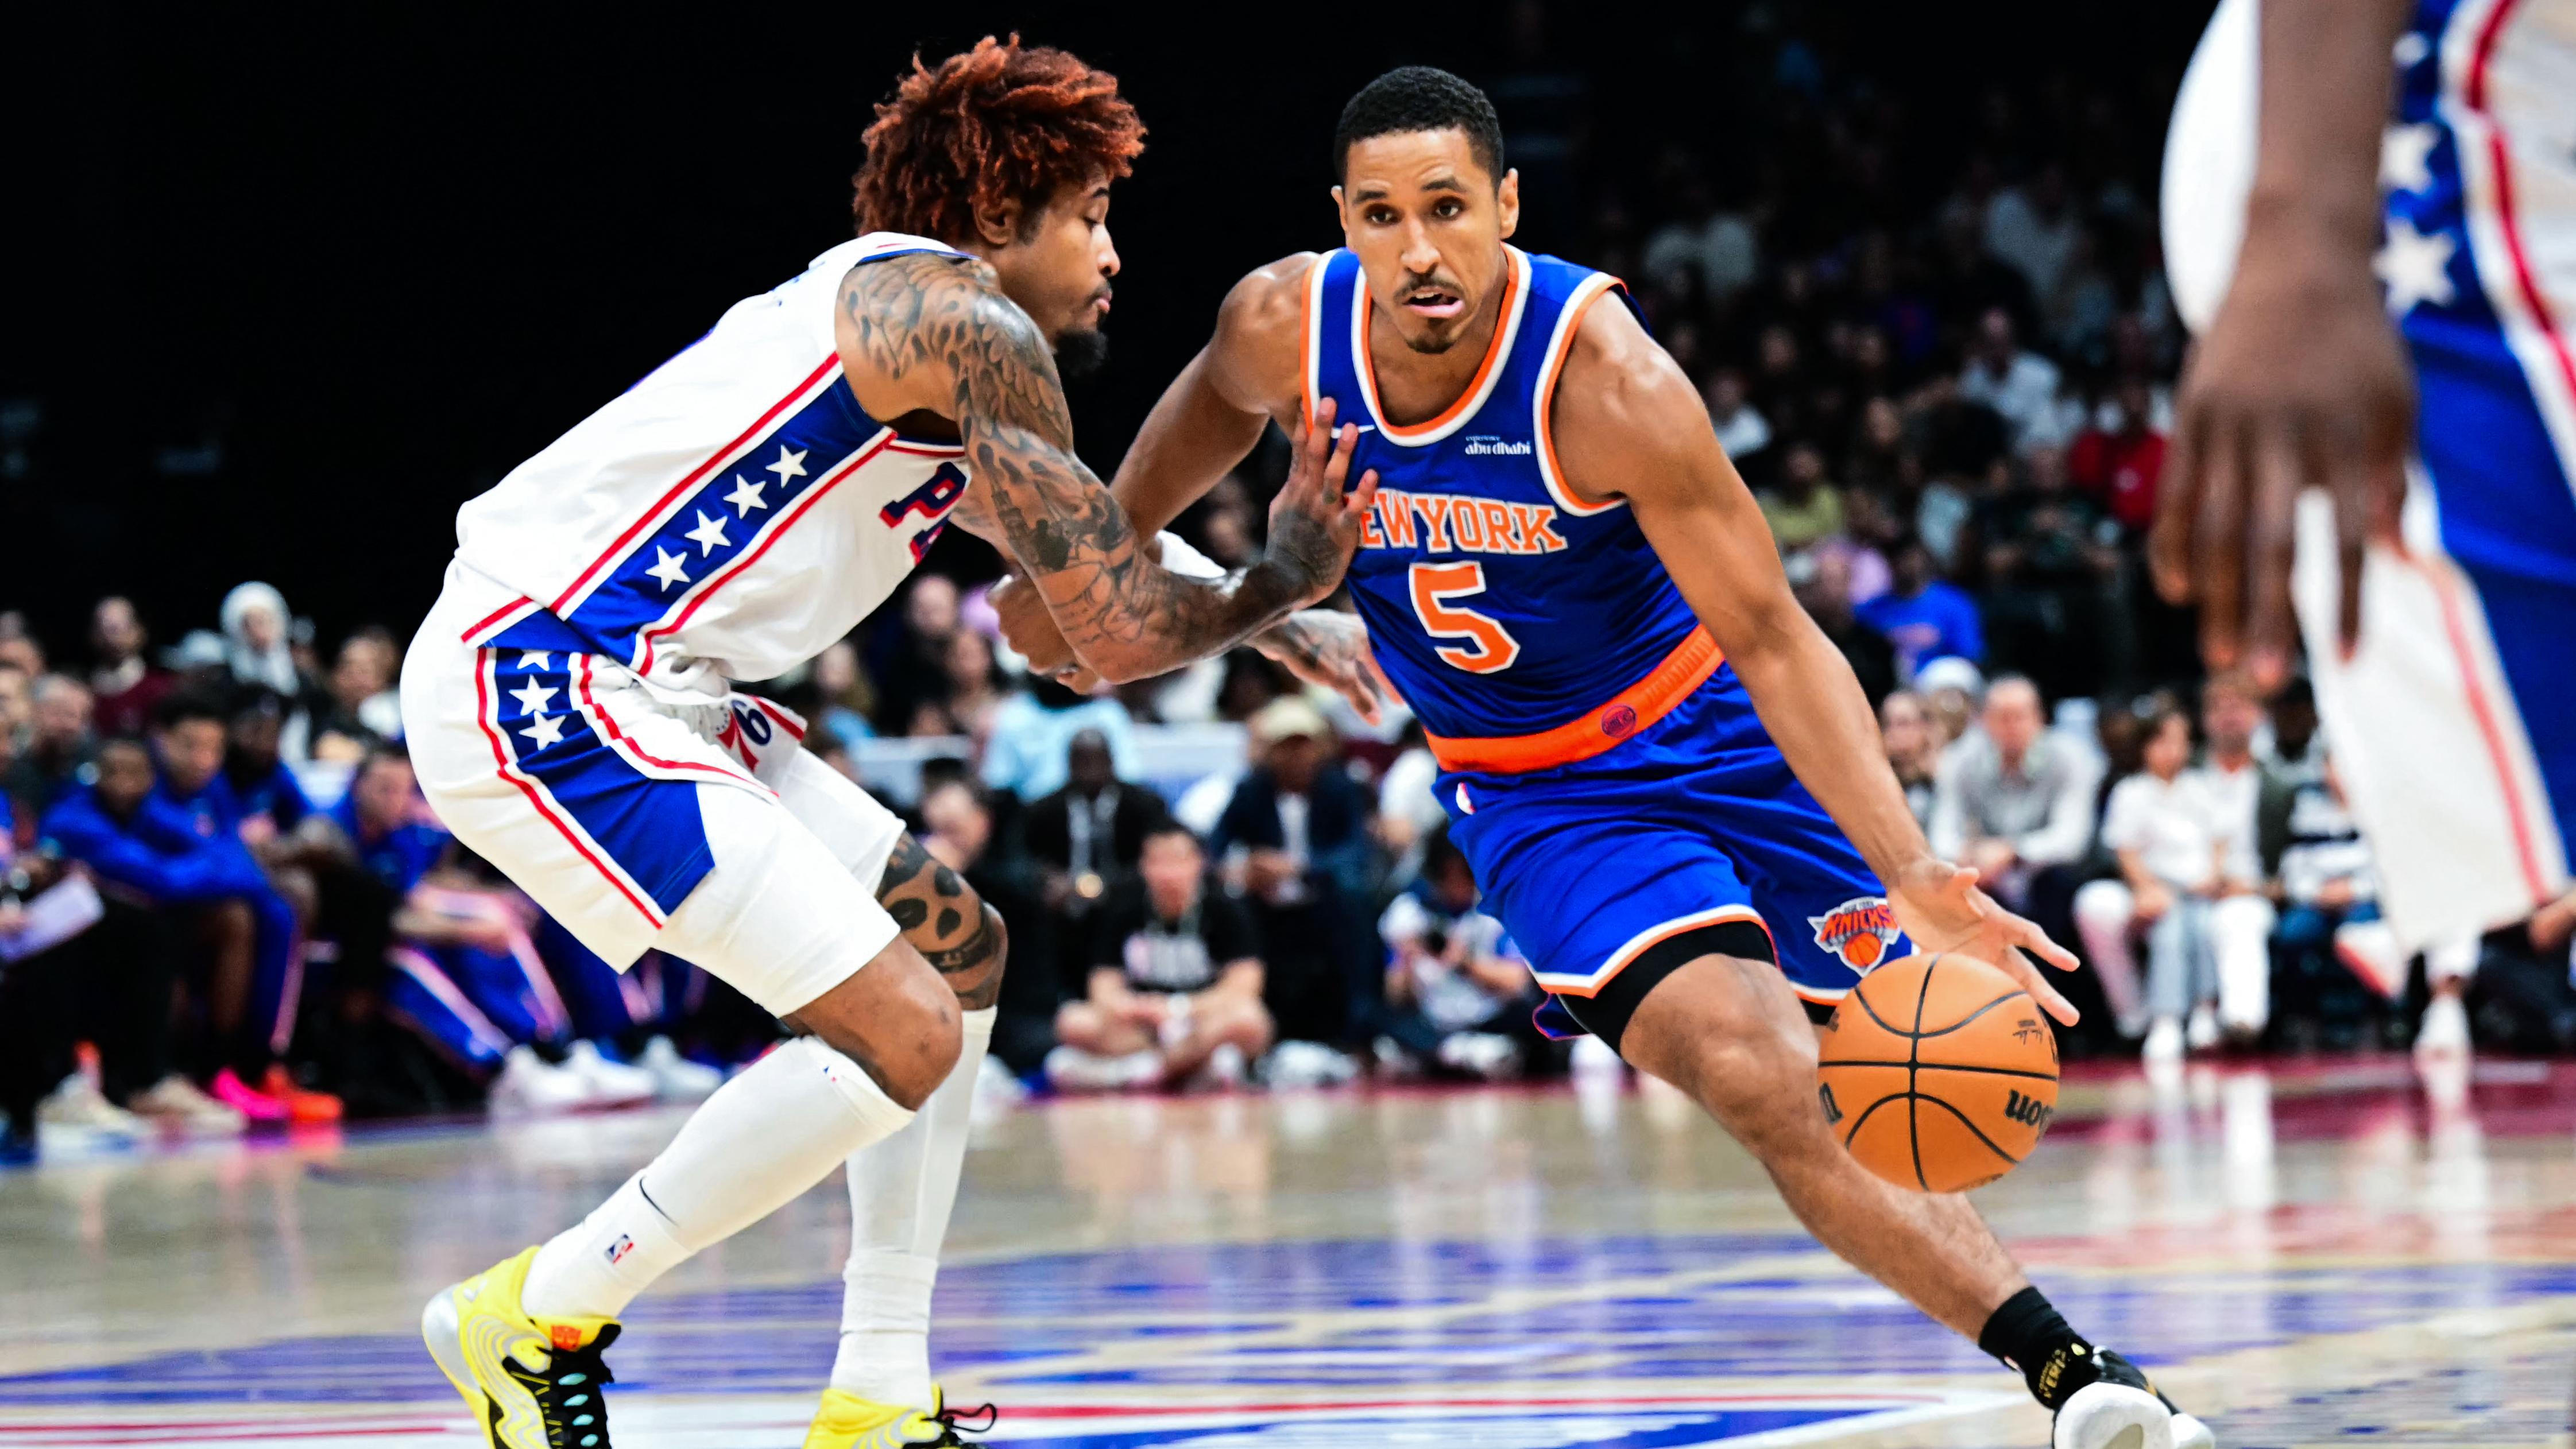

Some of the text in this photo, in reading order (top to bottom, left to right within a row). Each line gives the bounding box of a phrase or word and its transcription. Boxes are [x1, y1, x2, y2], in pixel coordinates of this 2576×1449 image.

[1344, 488, 1568, 555] EW YORK
[1409, 560, 1521, 674] 5
[1819, 904, 1899, 943] KNICKS
